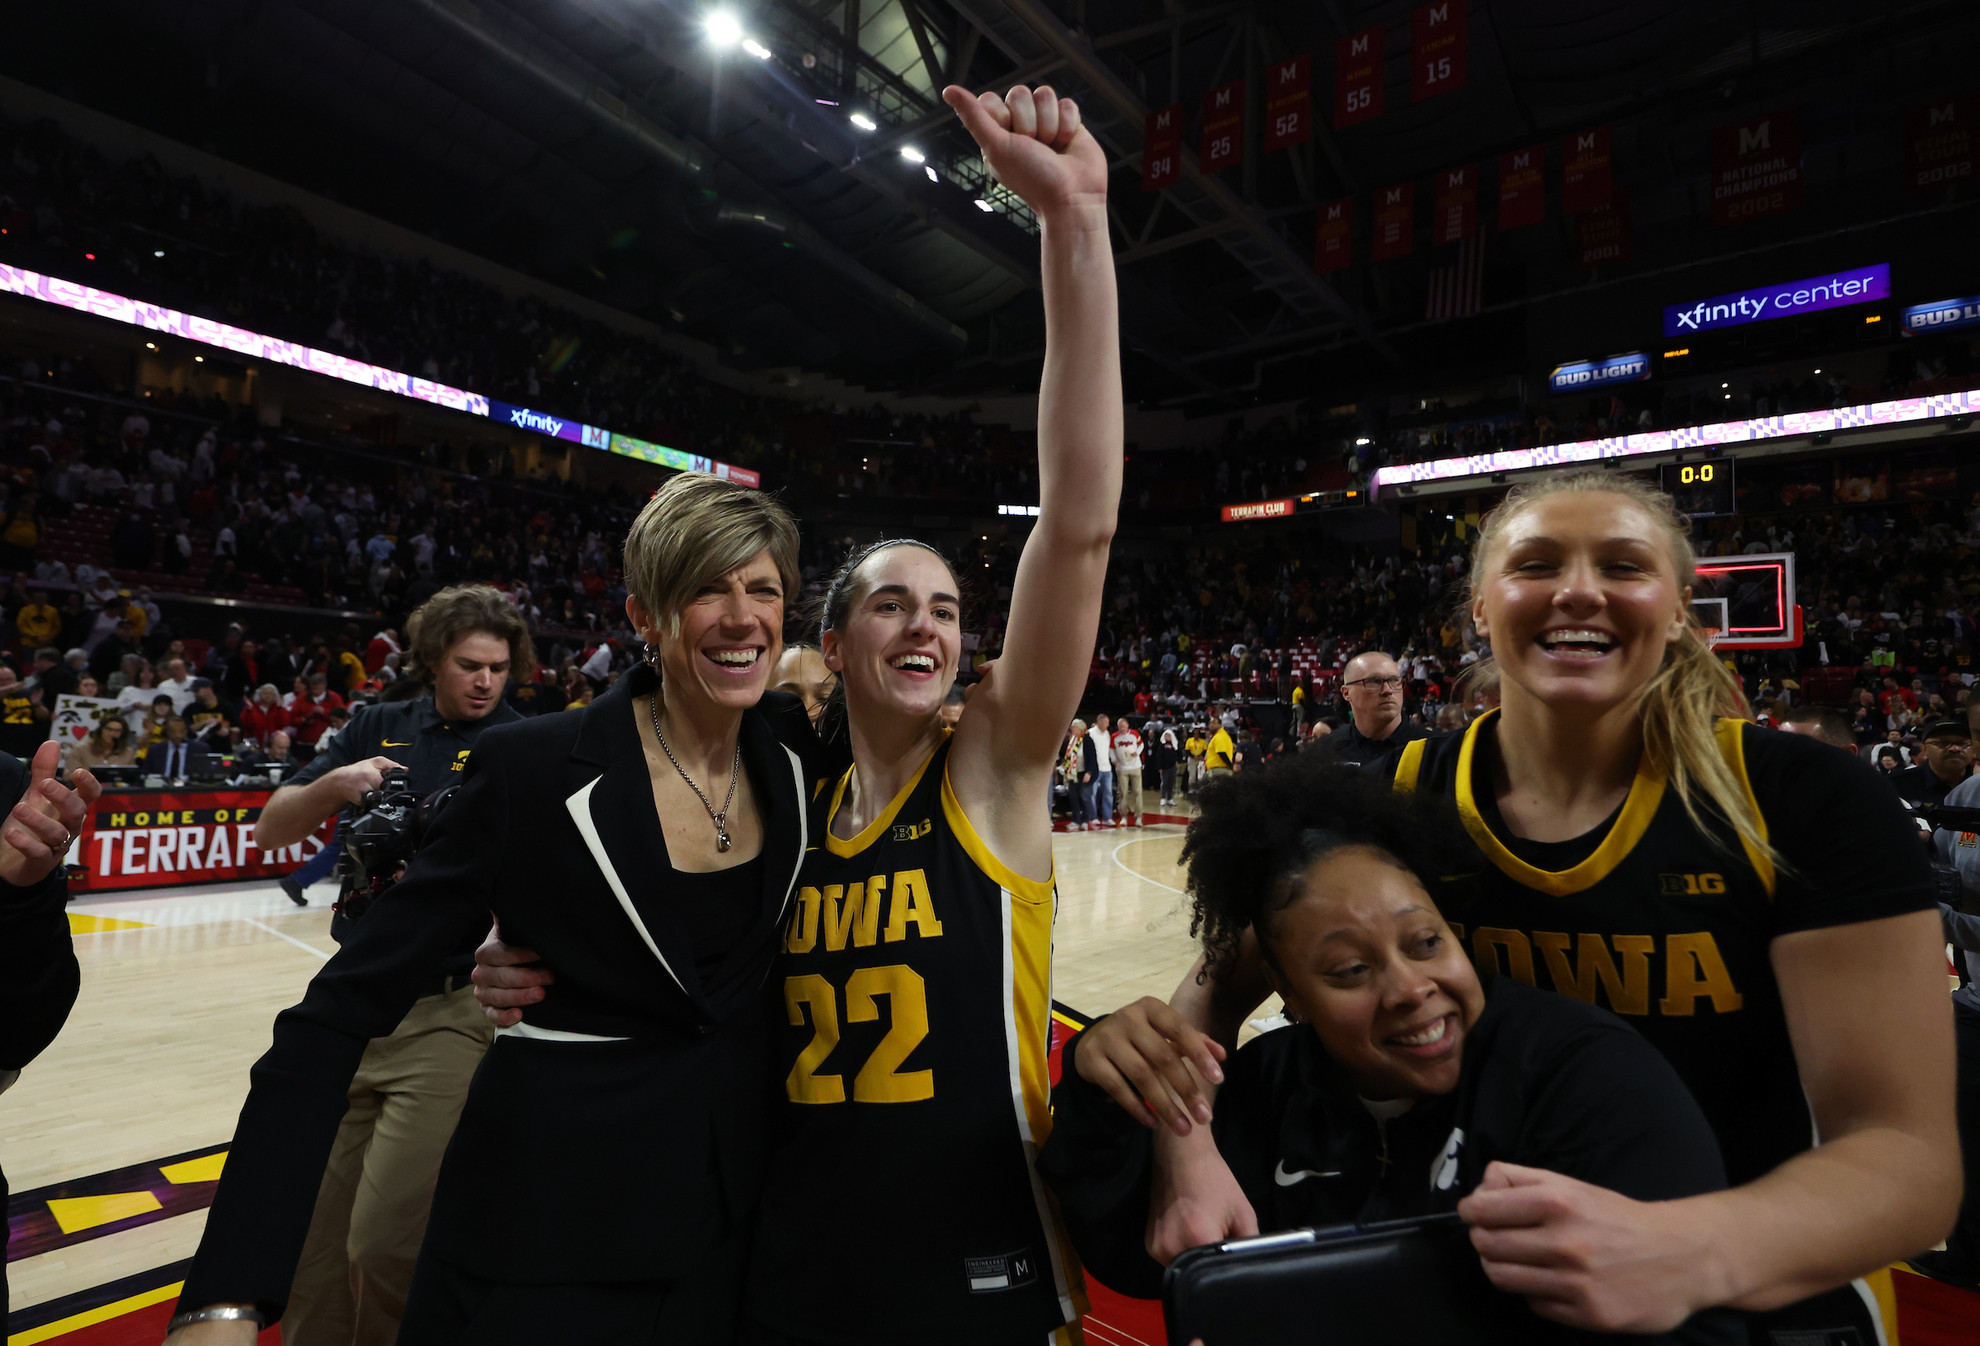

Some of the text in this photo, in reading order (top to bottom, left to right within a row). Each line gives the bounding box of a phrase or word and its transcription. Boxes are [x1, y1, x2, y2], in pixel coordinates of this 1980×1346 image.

[1430, 2, 1448, 27] M
[1351, 34, 1368, 57] M
[1280, 62, 1296, 84] M
[1426, 56, 1451, 85] 15
[1216, 88, 1230, 108] M
[1346, 86, 1371, 112] 55
[1157, 111, 1171, 130] M
[1276, 113, 1298, 137] 52
[1929, 103, 1955, 128] M
[1211, 136, 1231, 160] 25
[1578, 132, 1595, 152] M
[1737, 120, 1771, 156] M
[1152, 157, 1171, 179] 34
[1513, 152, 1529, 170] M
[1722, 156, 1789, 183] NATIONAL
[1448, 170, 1464, 188] M
[1714, 168, 1798, 199] CHAMPIONS
[1917, 160, 1973, 186] 2002
[1387, 188, 1401, 205] M
[1728, 192, 1783, 218] 2002
[1328, 204, 1341, 221] M
[1583, 244, 1621, 263] 2001
[1677, 275, 1874, 330] xfinity center
[1911, 308, 1961, 328] BUD
[1555, 361, 1644, 387] BUD LIGHT
[510, 408, 563, 437] xfinity
[589, 427, 603, 445] M
[1230, 502, 1285, 517] TERRAPIN CLUB
[110, 808, 248, 827] HOME OF
[1960, 831, 1976, 843] M
[1448, 921, 1743, 1017] OWA
[783, 964, 935, 1104] 22
[1015, 1258, 1029, 1277] M
